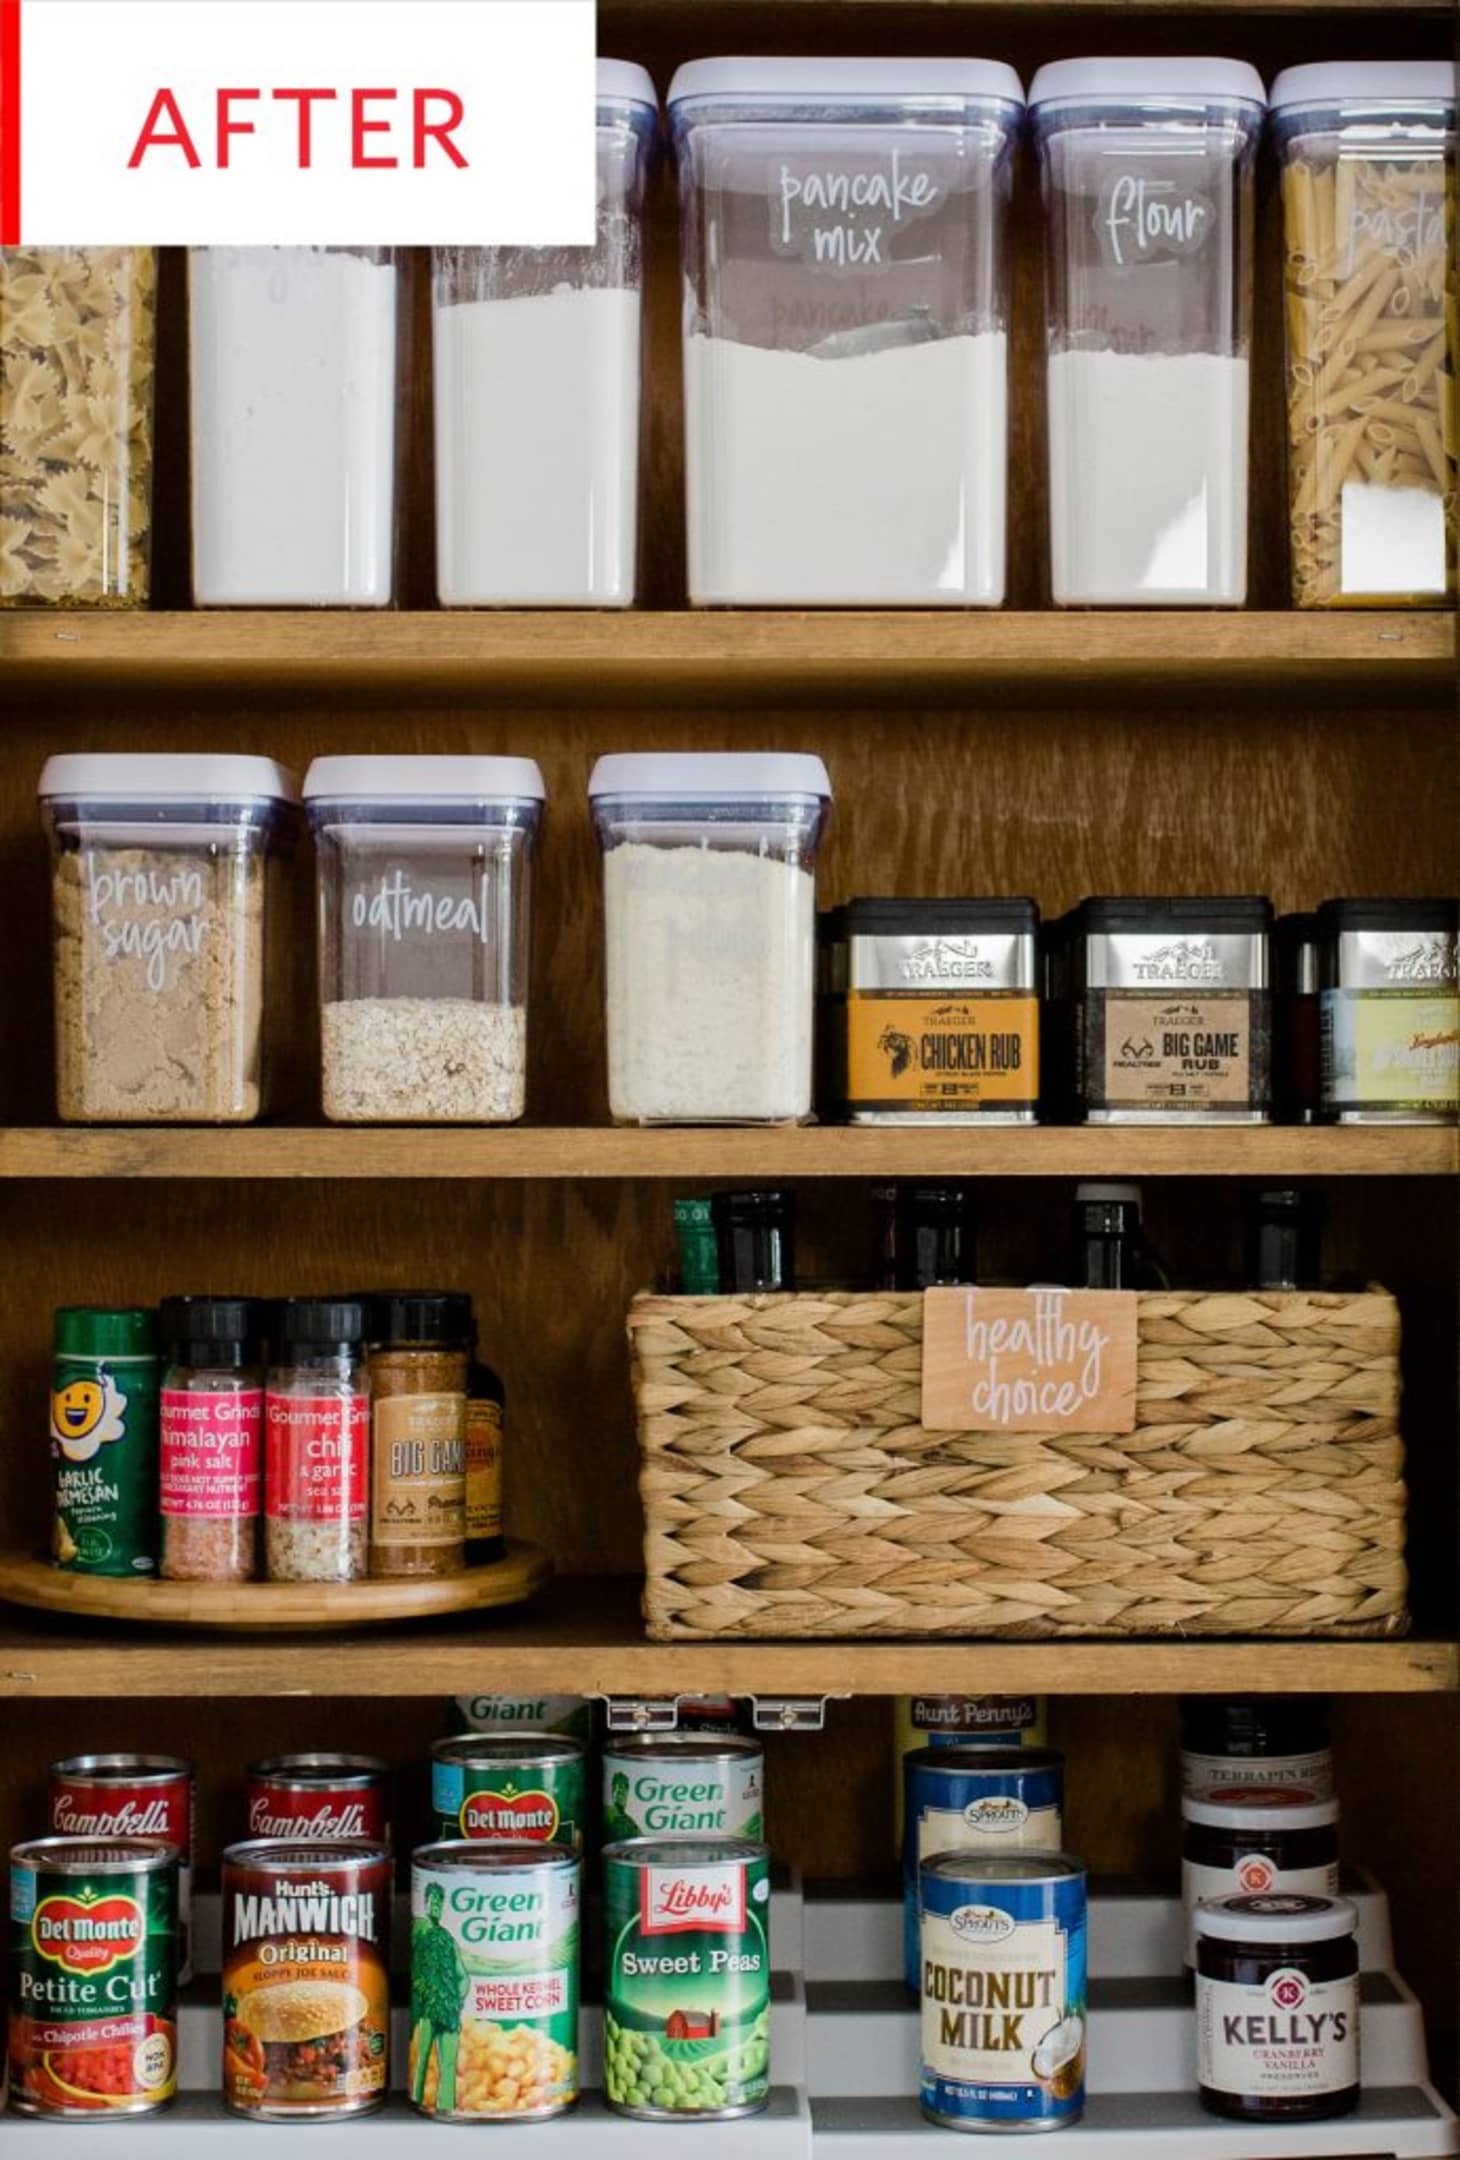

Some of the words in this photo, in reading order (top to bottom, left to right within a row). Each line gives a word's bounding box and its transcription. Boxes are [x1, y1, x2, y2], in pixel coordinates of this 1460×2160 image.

[780, 149, 939, 243] pancake
[1106, 176, 1205, 265] flour
[813, 211, 881, 267] mix
[87, 851, 206, 924] brown
[353, 869, 489, 943] oatmeal
[103, 913, 210, 991] sugar
[1386, 961, 1459, 980] TRAEG
[921, 1033, 986, 1070] CHICKEN
[990, 1033, 1021, 1070] RUB
[1163, 1033, 1190, 1057] BIG
[1193, 1033, 1239, 1057] GAME
[1181, 1058, 1220, 1070] RUB
[965, 1283, 1109, 1398] healthy
[972, 1355, 1084, 1424] choice
[205, 1454, 233, 1469] salt
[391, 1440, 425, 1476] BIG
[428, 1440, 465, 1475] GAM
[312, 1463, 358, 1482] garc
[470, 1695, 548, 1720] Giant
[914, 1701, 962, 1723] Aunt
[964, 1702, 1033, 1727] Penny's
[634, 1777, 725, 1802] Green
[53, 1794, 170, 1837] Campbell's
[250, 1797, 371, 1838] Campbell's
[467, 1808, 496, 1828] Del
[498, 1809, 553, 1830] Monte
[645, 1805, 726, 1831] Giant
[275, 1880, 331, 1897] Hunt's
[450, 1887, 543, 1913] Green
[656, 1880, 732, 1915] Libby's
[40, 1919, 69, 1939] Del
[73, 1918, 139, 1941] Monte
[233, 1893, 375, 1946] MANWICH
[461, 1916, 546, 1943] Giant
[65, 1944, 110, 1961] Quality
[259, 1941, 349, 1965] Original
[621, 1951, 701, 1974] Sweet
[709, 1949, 761, 1973] Peas
[20, 1971, 97, 2003] Petite
[106, 1973, 157, 2001] Cut
[475, 1983, 520, 1997] WHOLE
[522, 1977, 562, 1994] KEEL
[924, 1960, 1056, 2010] COCONUT
[475, 1996, 522, 2012] SWEET
[525, 1991, 560, 2010] CORN
[940, 2007, 1023, 2051] MILK
[1223, 2011, 1347, 2045] KELLY'S
[1252, 2048, 1326, 2060] CRANBERRY
[1264, 2059, 1316, 2070] VANILLA
